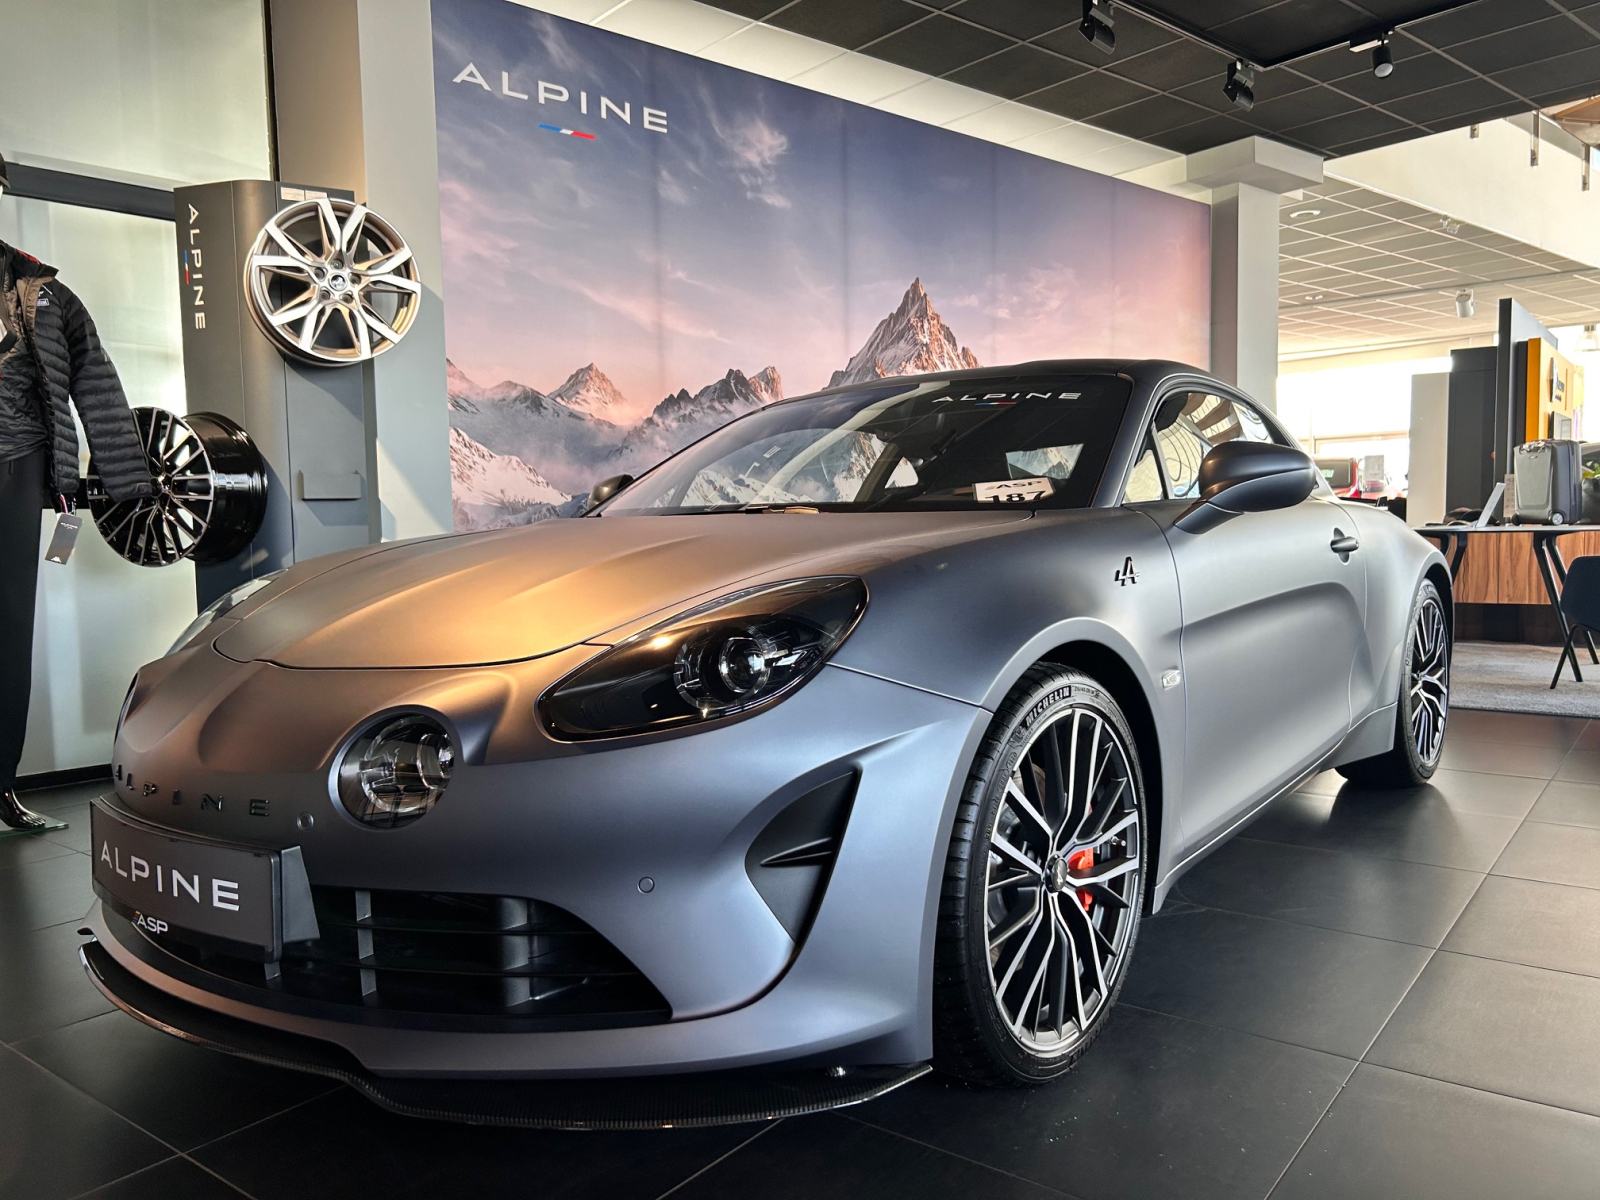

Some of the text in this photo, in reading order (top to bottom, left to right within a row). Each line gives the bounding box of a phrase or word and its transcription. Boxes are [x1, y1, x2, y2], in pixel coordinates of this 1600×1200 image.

[452, 62, 669, 134] ALPINE
[188, 203, 206, 330] ALPINE
[932, 392, 1082, 403] ALPINE
[985, 490, 1046, 502] 187
[1026, 686, 1071, 727] MICHELIN
[115, 764, 270, 817] ALPINE
[100, 839, 240, 912] ALPINE
[136, 914, 169, 934] ASP
